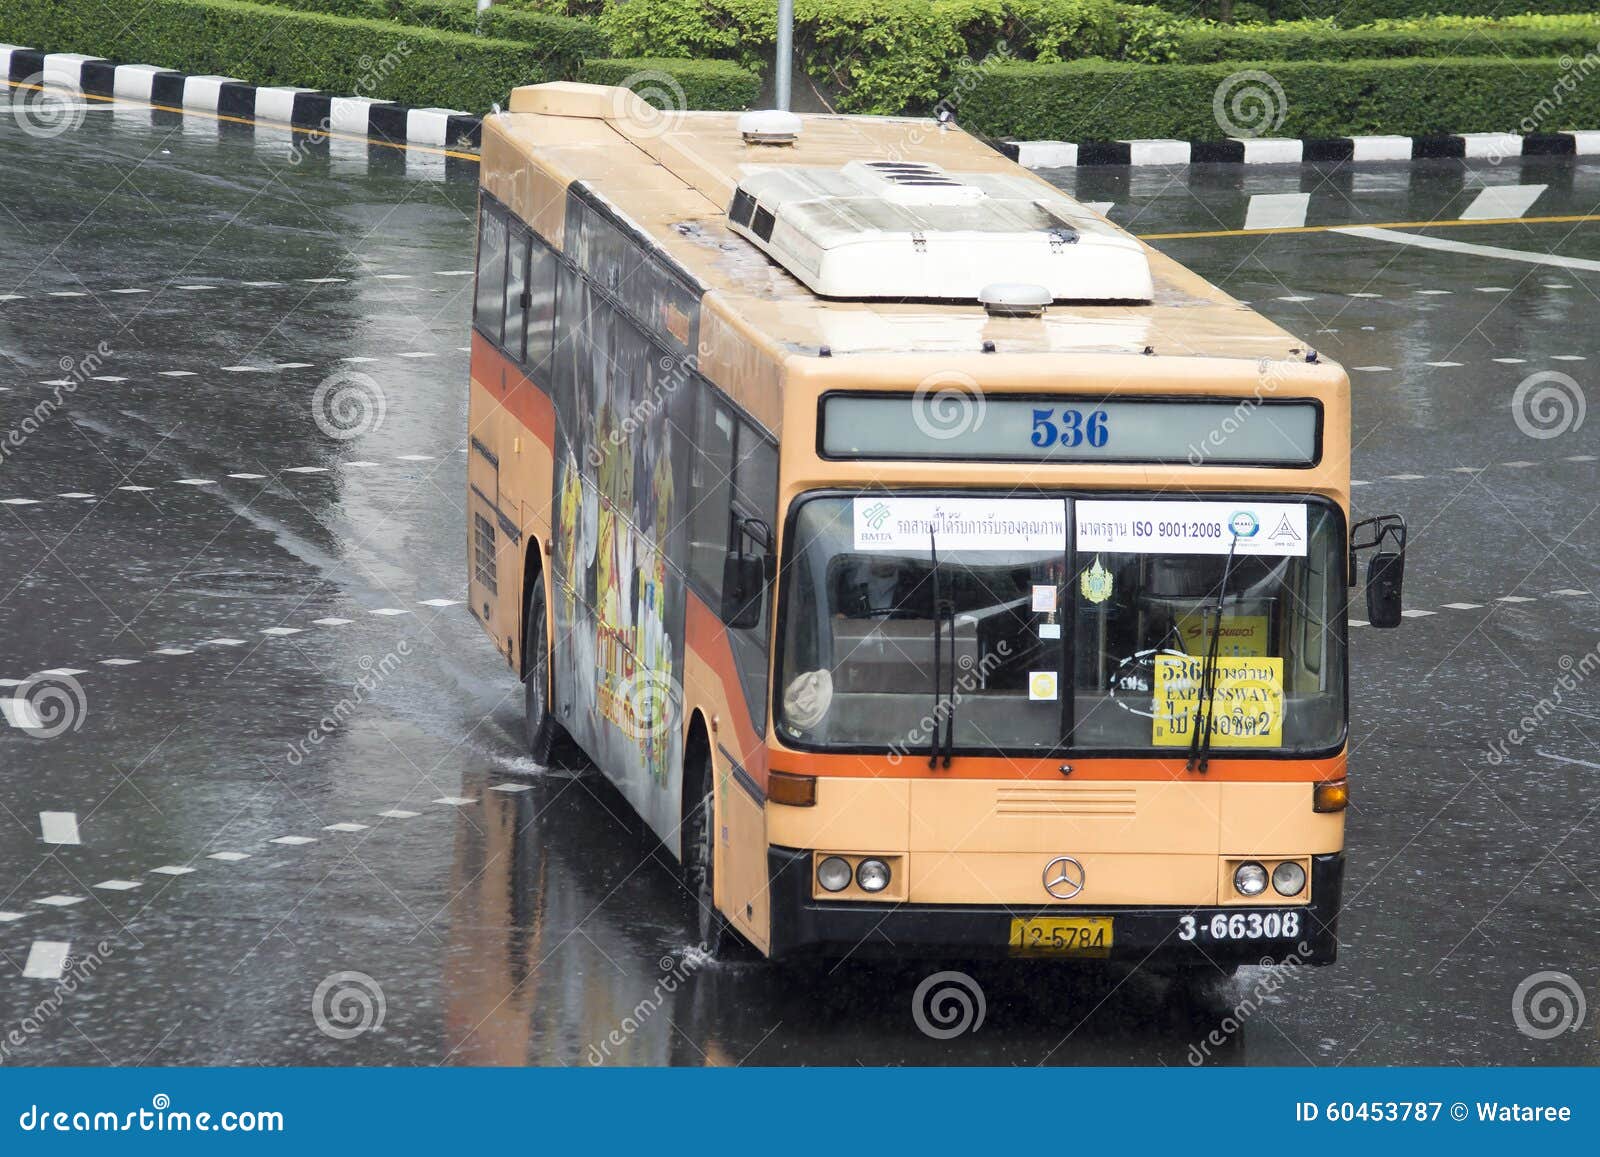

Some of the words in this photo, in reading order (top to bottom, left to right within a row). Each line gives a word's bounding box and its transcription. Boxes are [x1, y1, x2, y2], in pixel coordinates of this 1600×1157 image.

[1031, 408, 1109, 448] 536
[1080, 521, 1127, 542] มาตรฐาน
[1132, 520, 1153, 537] ISO
[1158, 521, 1222, 538] 9001:2008
[1162, 660, 1201, 681] 536
[1020, 926, 1105, 950] 12-5784
[1178, 912, 1300, 941] 3-66308
